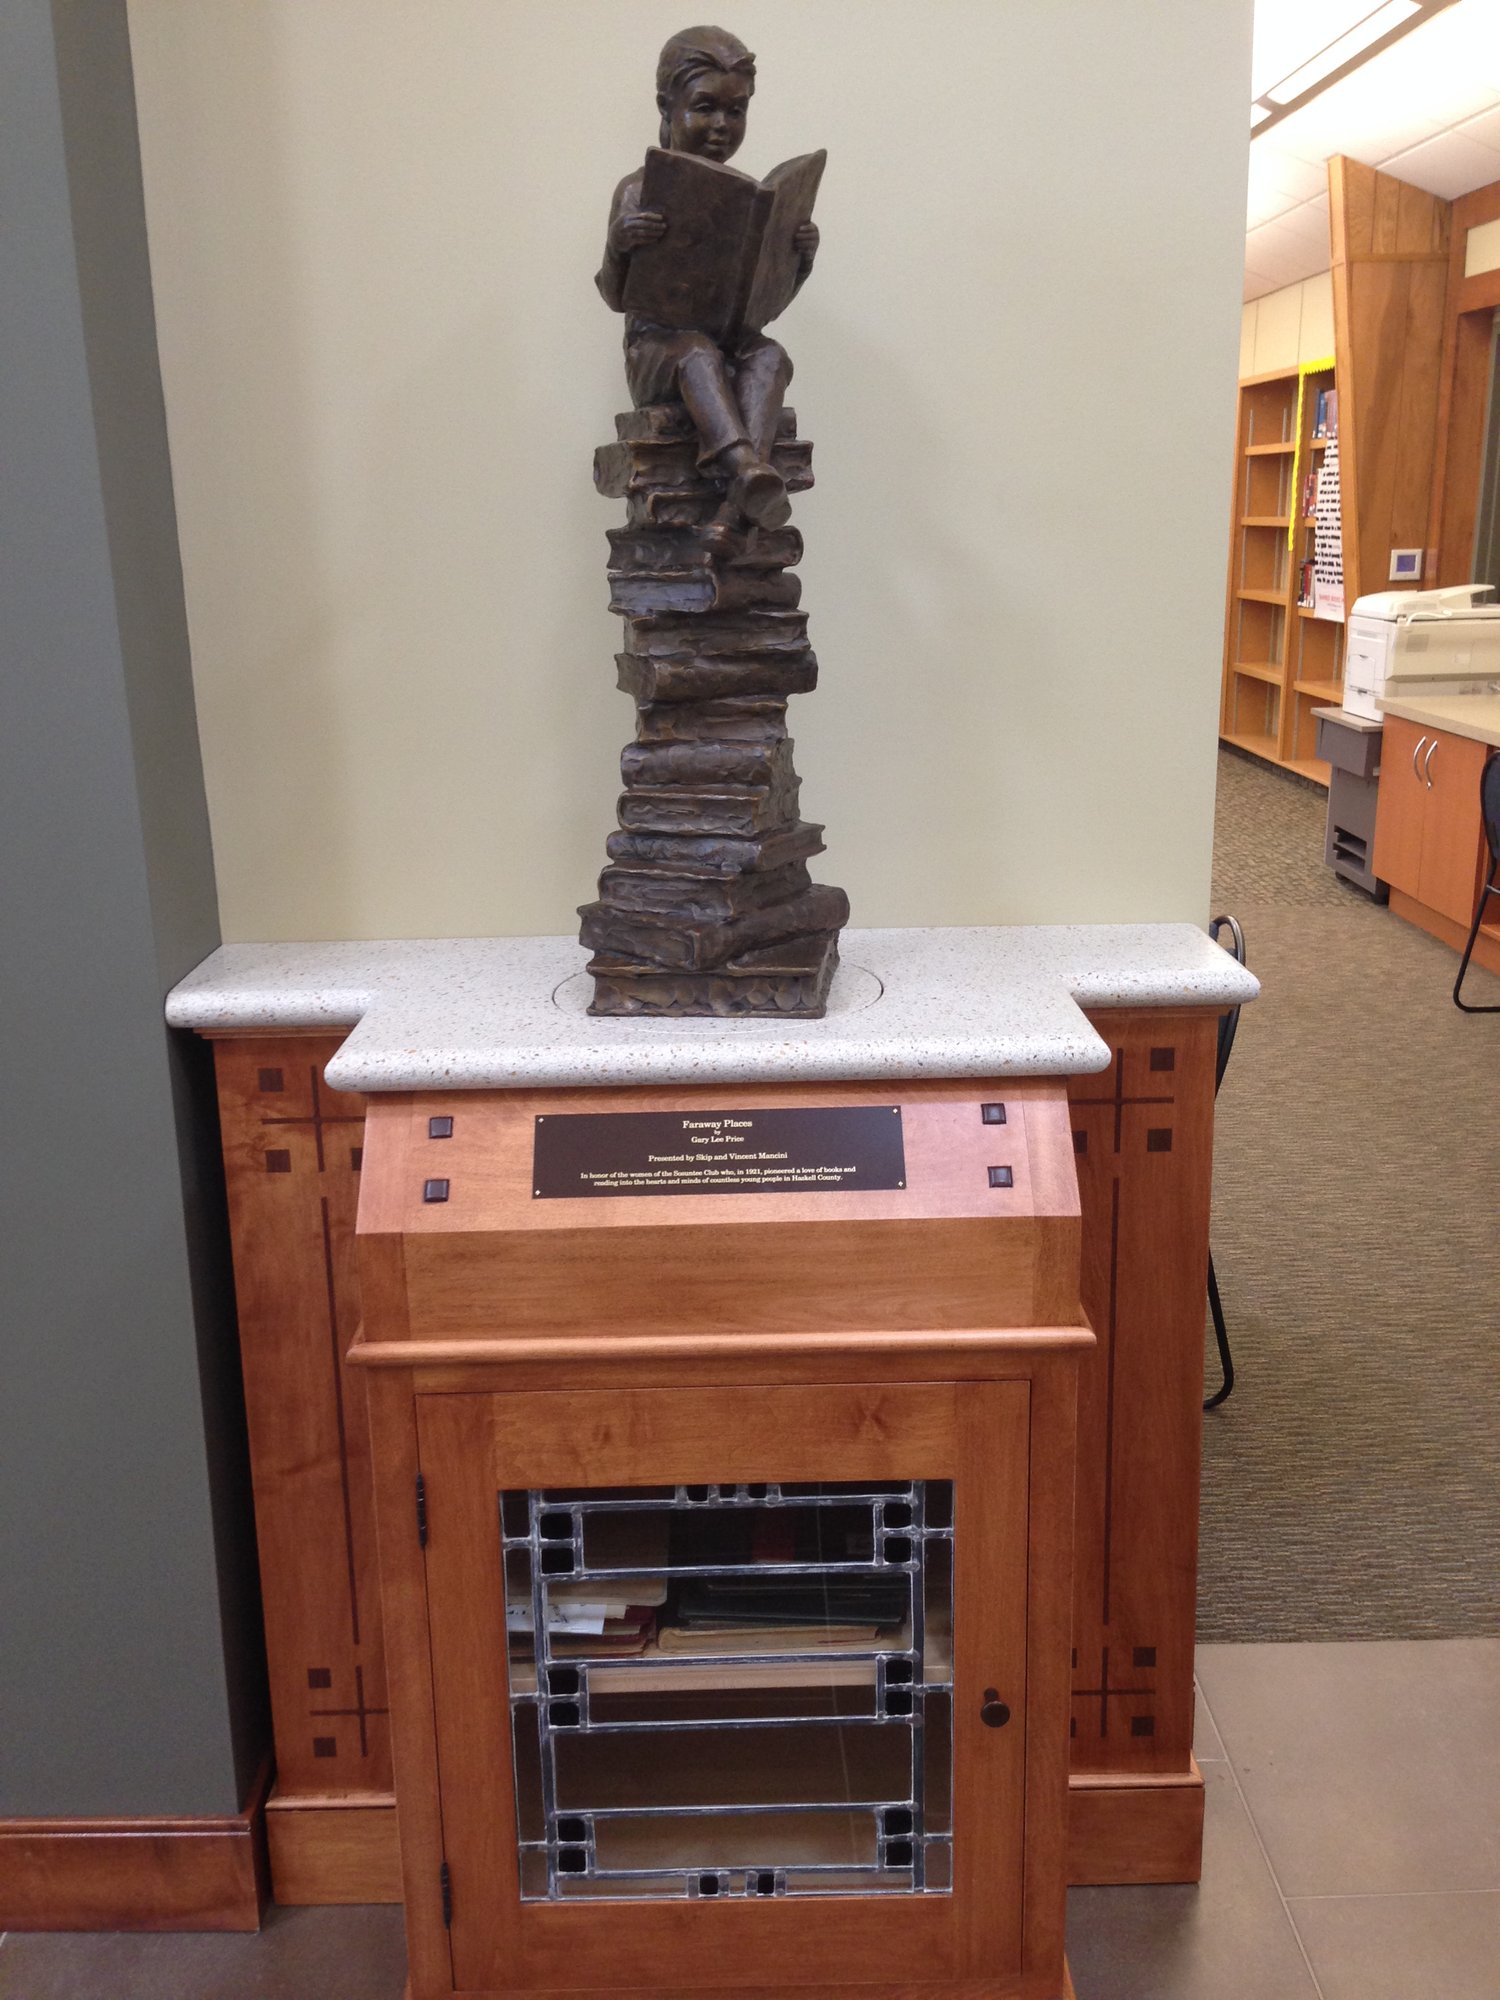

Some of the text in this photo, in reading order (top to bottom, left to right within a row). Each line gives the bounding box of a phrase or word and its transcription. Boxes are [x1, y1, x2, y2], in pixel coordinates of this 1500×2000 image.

[682, 1119, 753, 1129] Faraway Places
[691, 1136, 709, 1145] Gary
[725, 1135, 745, 1143] Price
[648, 1151, 788, 1163] Presented by Skip and Vincent Mancini
[609, 1171, 618, 1179] of
[653, 1170, 662, 1178] of
[662, 1170, 672, 1178] the
[720, 1169, 736, 1177] who,
[745, 1168, 763, 1176] 1921,
[763, 1167, 795, 1176] pioneered
[843, 1165, 856, 1173] and
[594, 1179, 618, 1187] reading
[619, 1178, 633, 1186] into
[633, 1178, 645, 1186] the
[681, 1177, 701, 1185] minds
[709, 1176, 740, 1184] countless
[740, 1176, 761, 1185] young
[762, 1176, 783, 1184] people
[791, 1174, 817, 1182] Haskell
[817, 1173, 843, 1182] County.
